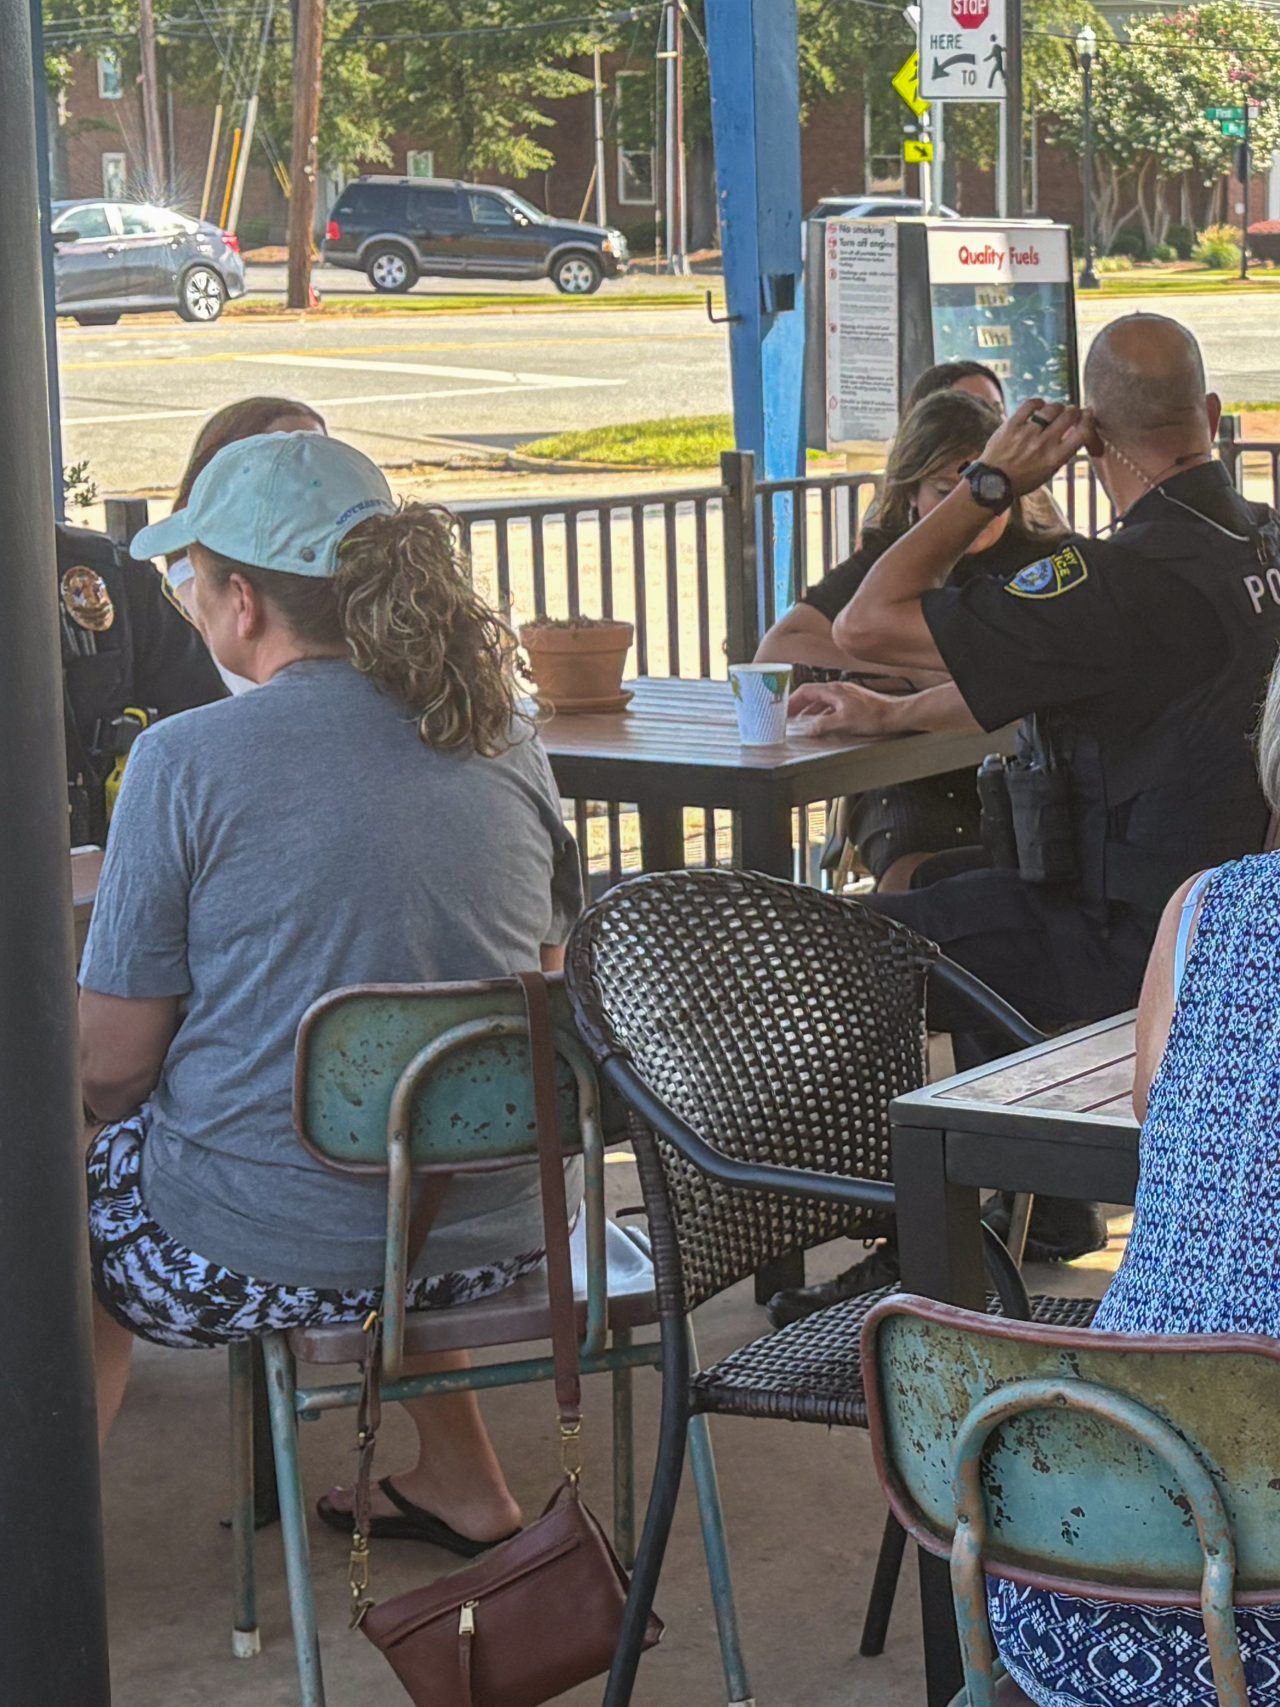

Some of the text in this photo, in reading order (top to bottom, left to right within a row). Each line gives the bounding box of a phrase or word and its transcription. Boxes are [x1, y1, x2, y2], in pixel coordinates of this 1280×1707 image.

[953, 0, 987, 15] STOP
[930, 34, 962, 49] HERE
[962, 70, 976, 85] TO
[853, 225, 885, 237] smoking
[840, 237, 896, 251] Turn off engine
[958, 245, 1040, 271] Quality Fuels
